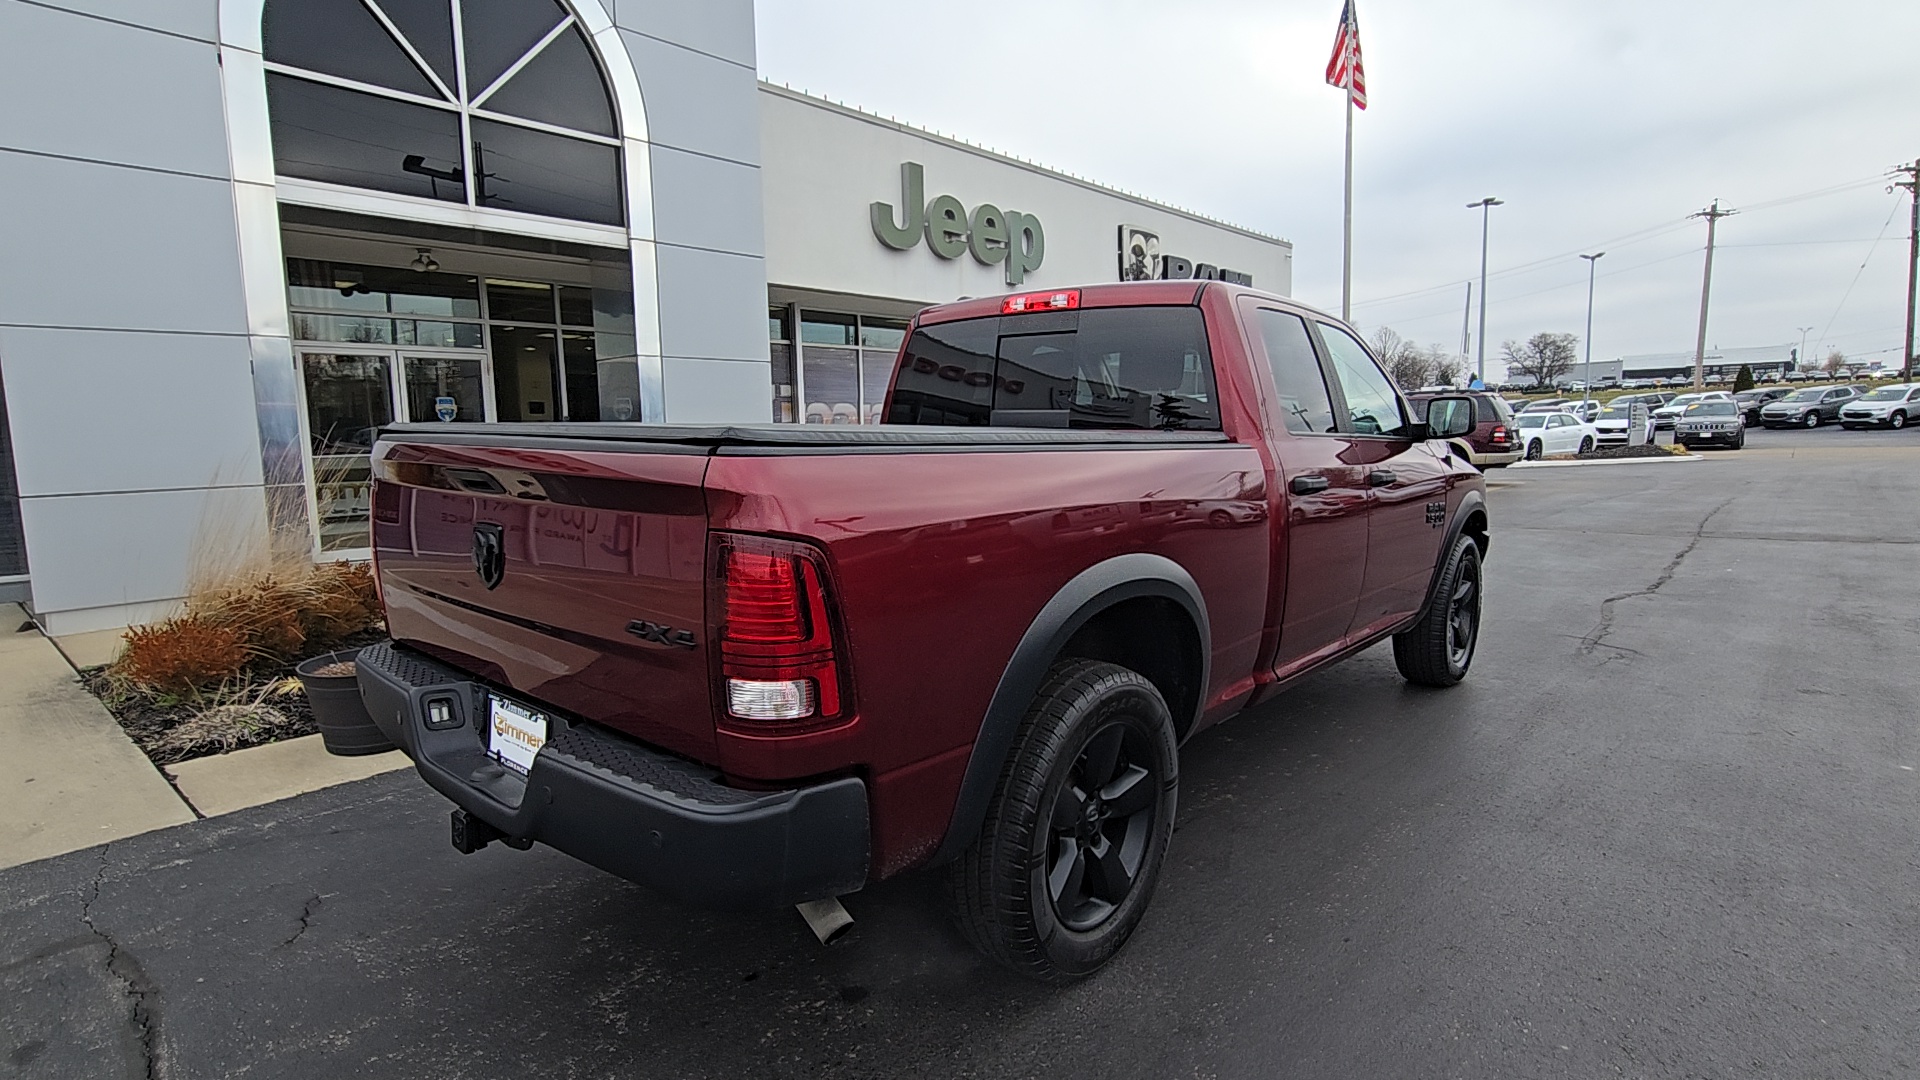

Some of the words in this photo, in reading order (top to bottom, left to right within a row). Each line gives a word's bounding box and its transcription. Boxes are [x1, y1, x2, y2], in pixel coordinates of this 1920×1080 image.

[870, 161, 1046, 286] Jeep
[1162, 255, 1253, 288] RAM
[496, 715, 544, 748] Zimmer
